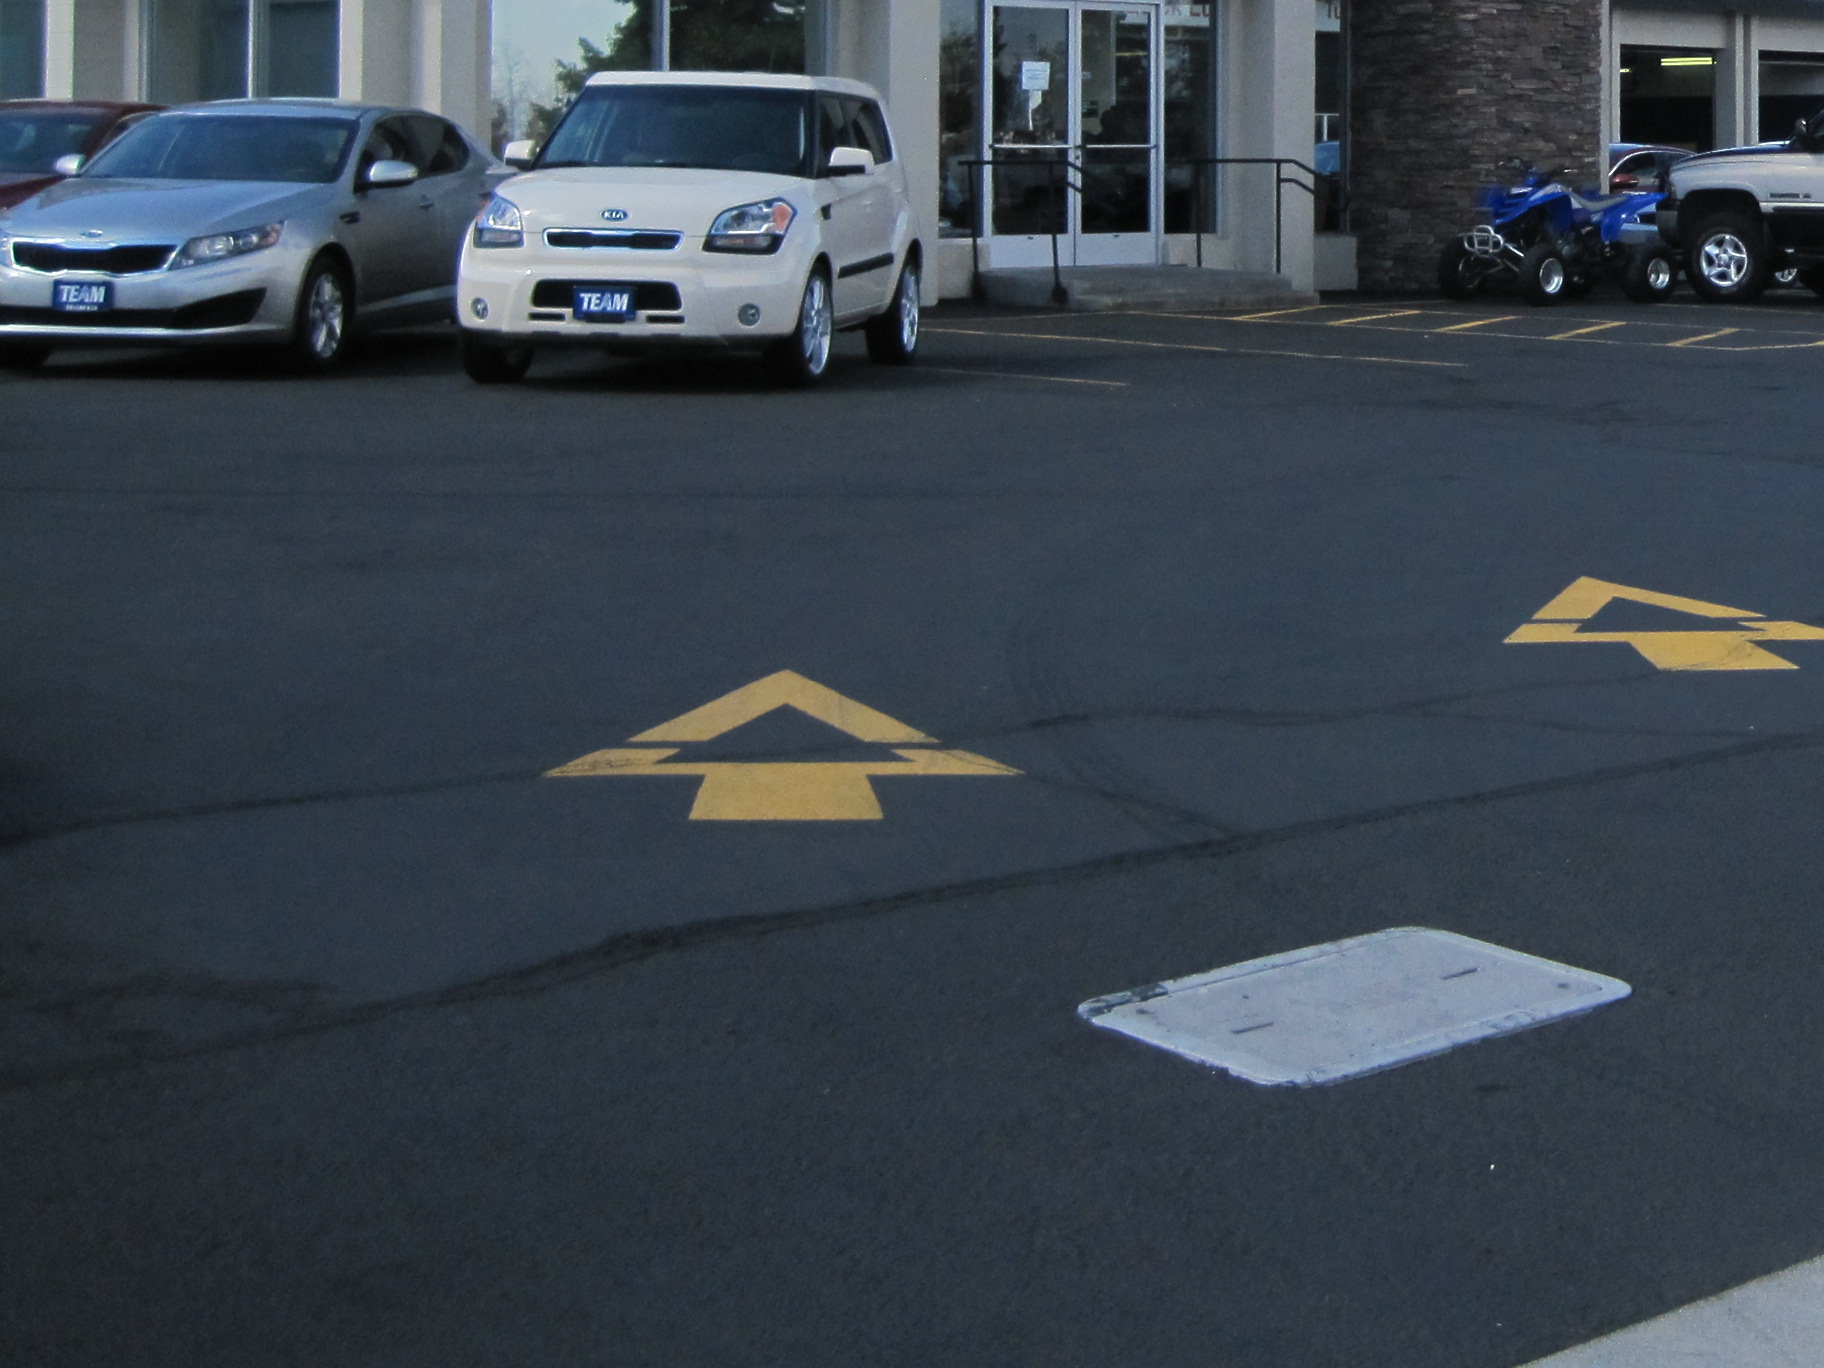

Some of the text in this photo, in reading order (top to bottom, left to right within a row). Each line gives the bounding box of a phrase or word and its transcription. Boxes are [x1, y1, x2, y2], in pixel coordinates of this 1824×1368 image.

[603, 211, 624, 219] KIA
[60, 284, 106, 303] TEAM
[579, 292, 629, 311] TEAM
